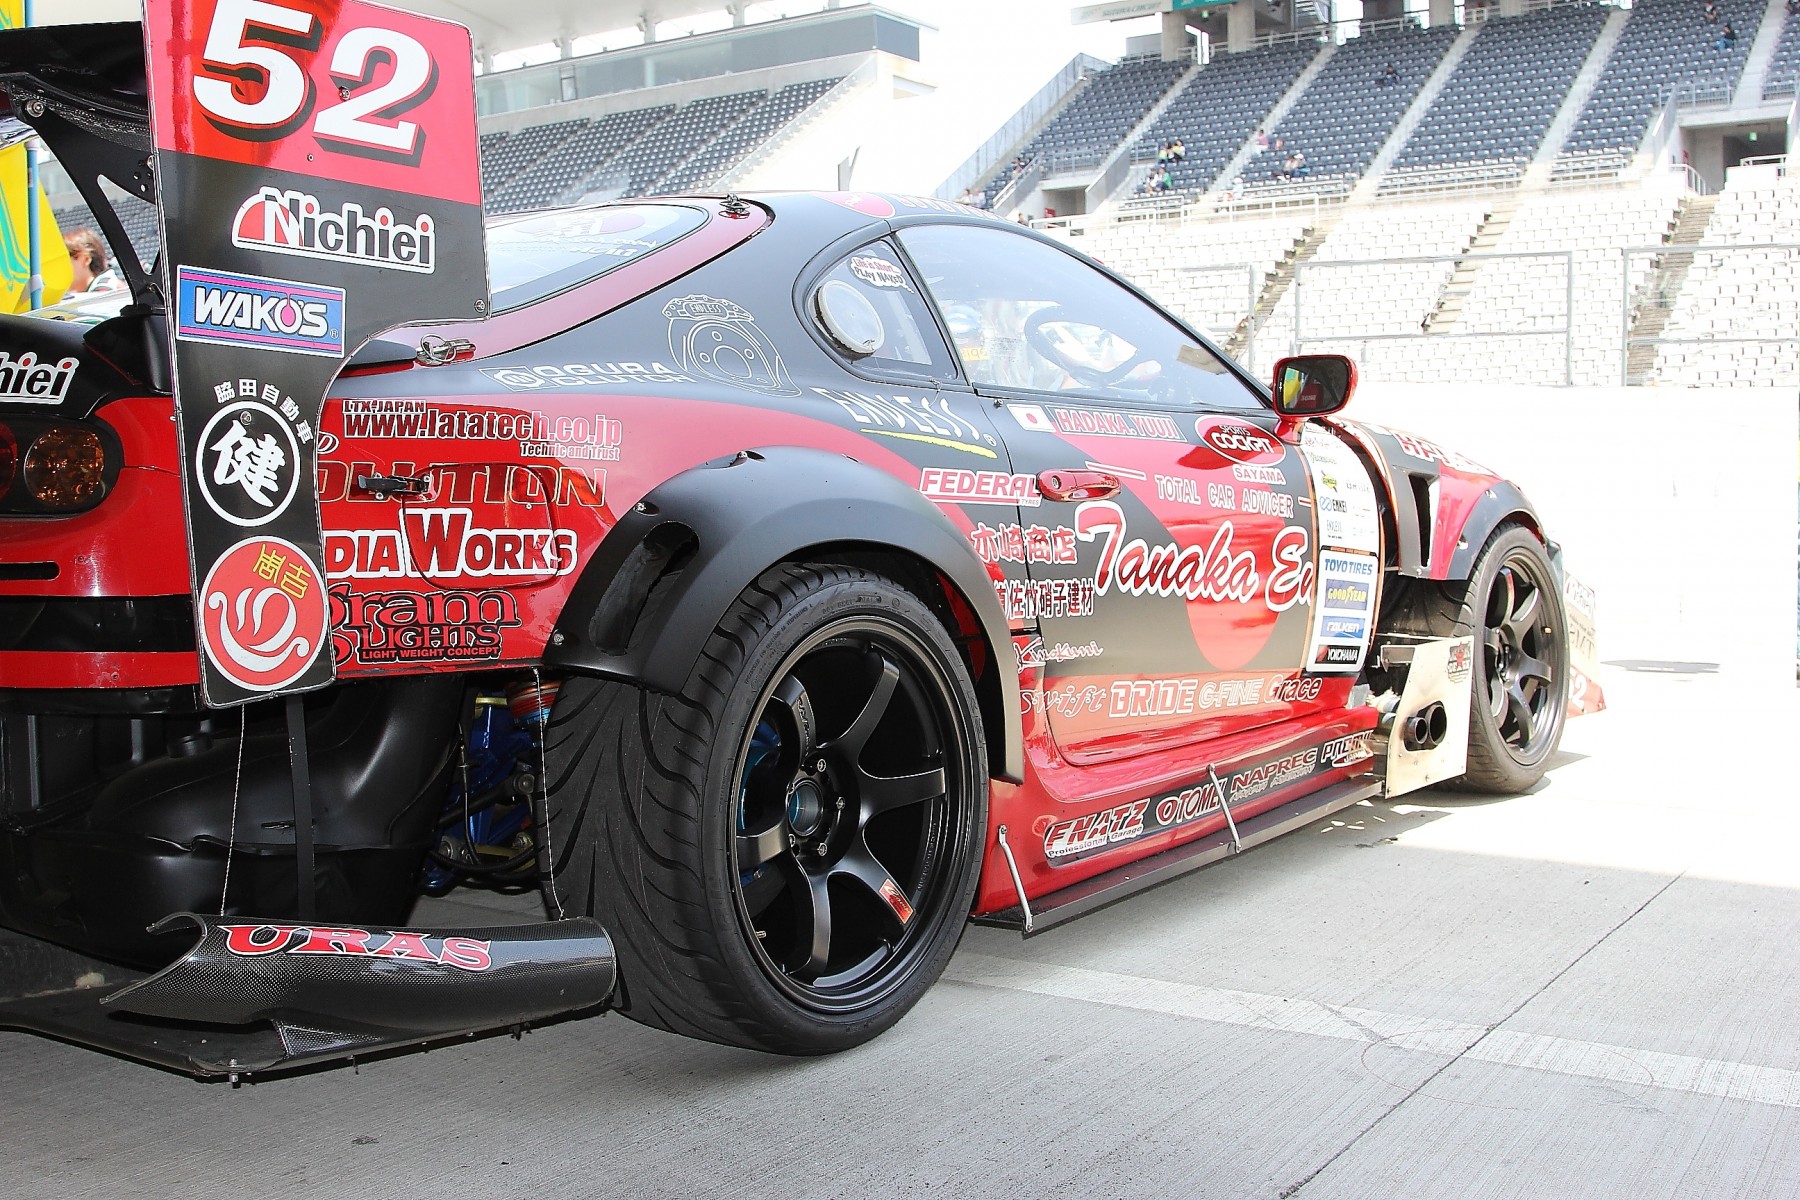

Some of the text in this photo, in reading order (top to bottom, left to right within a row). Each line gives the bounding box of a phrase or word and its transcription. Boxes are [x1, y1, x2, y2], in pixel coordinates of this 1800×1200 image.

[193, 0, 436, 158] 52
[250, 190, 433, 270] Nichiei
[854, 266, 904, 285] PLAY NAKED
[195, 286, 328, 338] WAKO'S
[689, 303, 722, 313] ENDLESS
[532, 362, 678, 377] OGURA
[552, 374, 697, 387] CLUTCH
[345, 409, 622, 446] www.latatech.co.jp
[810, 386, 981, 441] ENDLESS
[1211, 432, 1275, 454] COCKPIT
[1218, 424, 1251, 436] SPORTS
[210, 420, 286, 507] 健
[521, 442, 619, 461] Technic and Trust
[921, 469, 1040, 498] FEDERAL
[1233, 465, 1285, 484] SAYAMA
[1154, 475, 1294, 518] TOTAL CAR ADVICER
[972, 524, 1076, 562] 木崎商店
[1077, 502, 1257, 601] Tanaka
[1324, 558, 1373, 576] TOYO TIRES
[362, 624, 500, 650] LIGHTS
[1326, 621, 1360, 633] FALKEN
[362, 646, 499, 660] LIGHT WEIGHT CONCEPT
[1327, 647, 1359, 661] YOKOHAMA
[1109, 678, 1198, 718] BRIDE
[1263, 674, 1322, 704] Grace
[1231, 747, 1318, 793] NAPREC
[1047, 825, 1144, 857] Professional Garage
[215, 923, 493, 972] URAS
